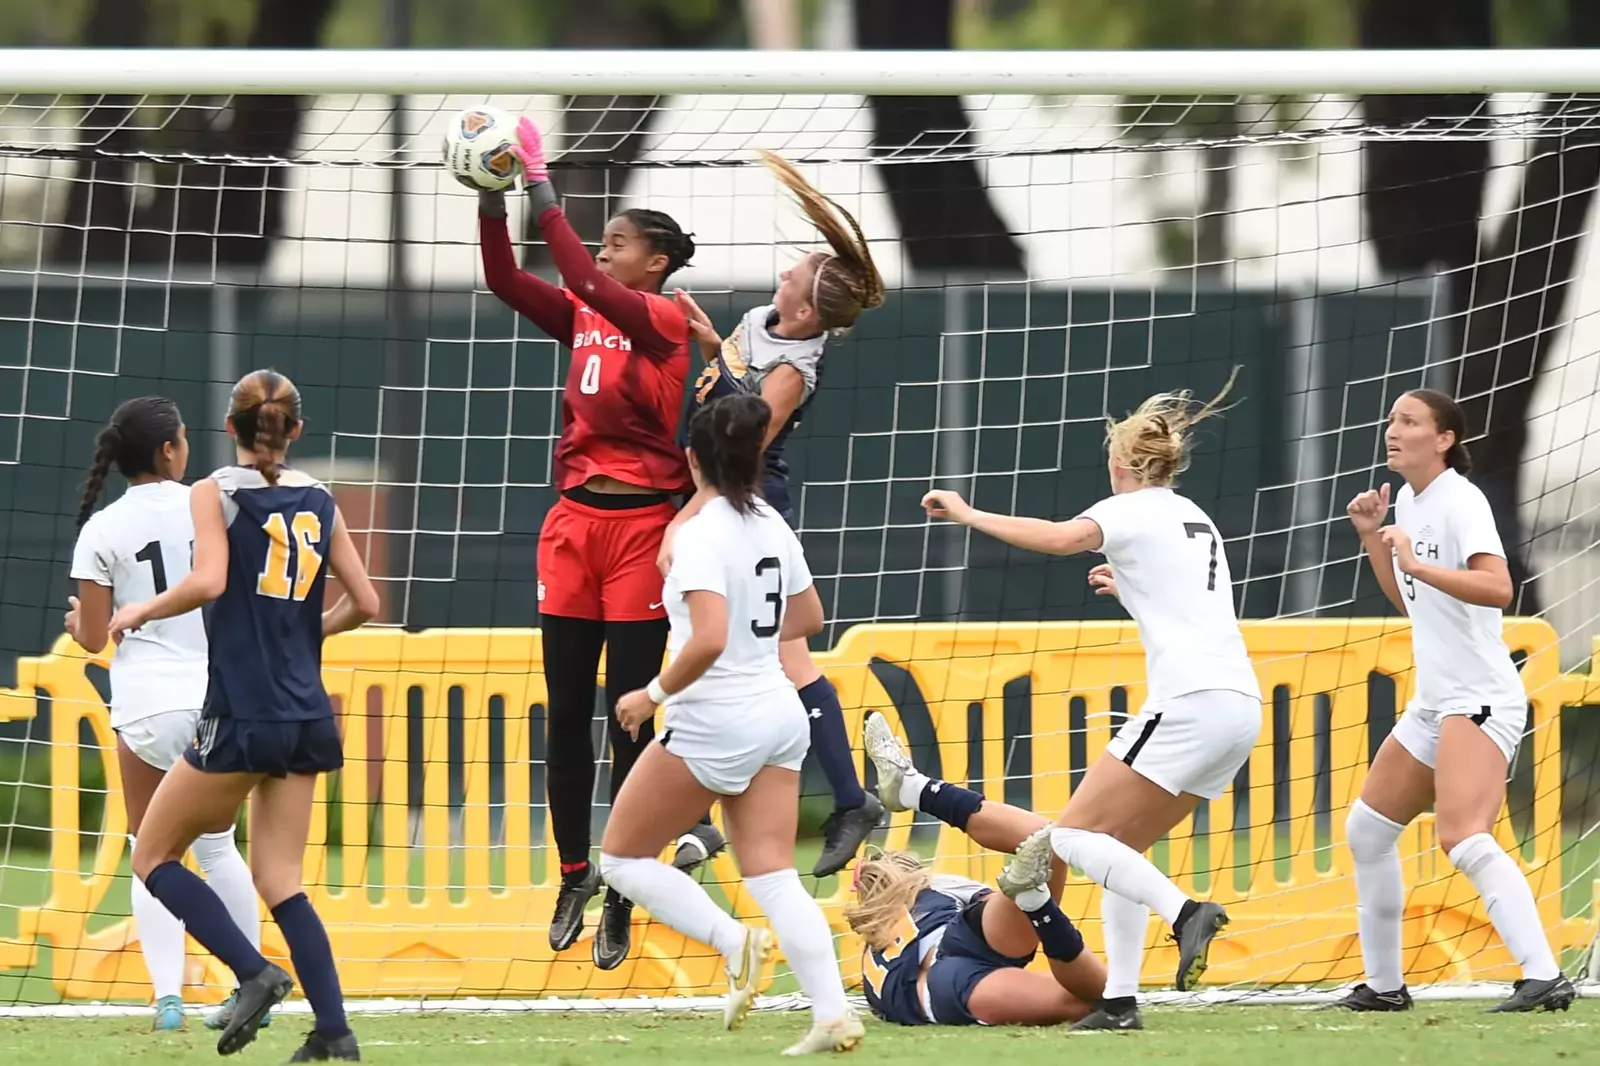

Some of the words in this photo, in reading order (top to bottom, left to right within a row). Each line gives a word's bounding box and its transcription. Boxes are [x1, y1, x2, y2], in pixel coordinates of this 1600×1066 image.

[580, 354, 602, 395] 0
[135, 540, 195, 595] 1
[256, 511, 322, 602] 16
[1182, 522, 1217, 592] 7
[751, 557, 782, 638] 3
